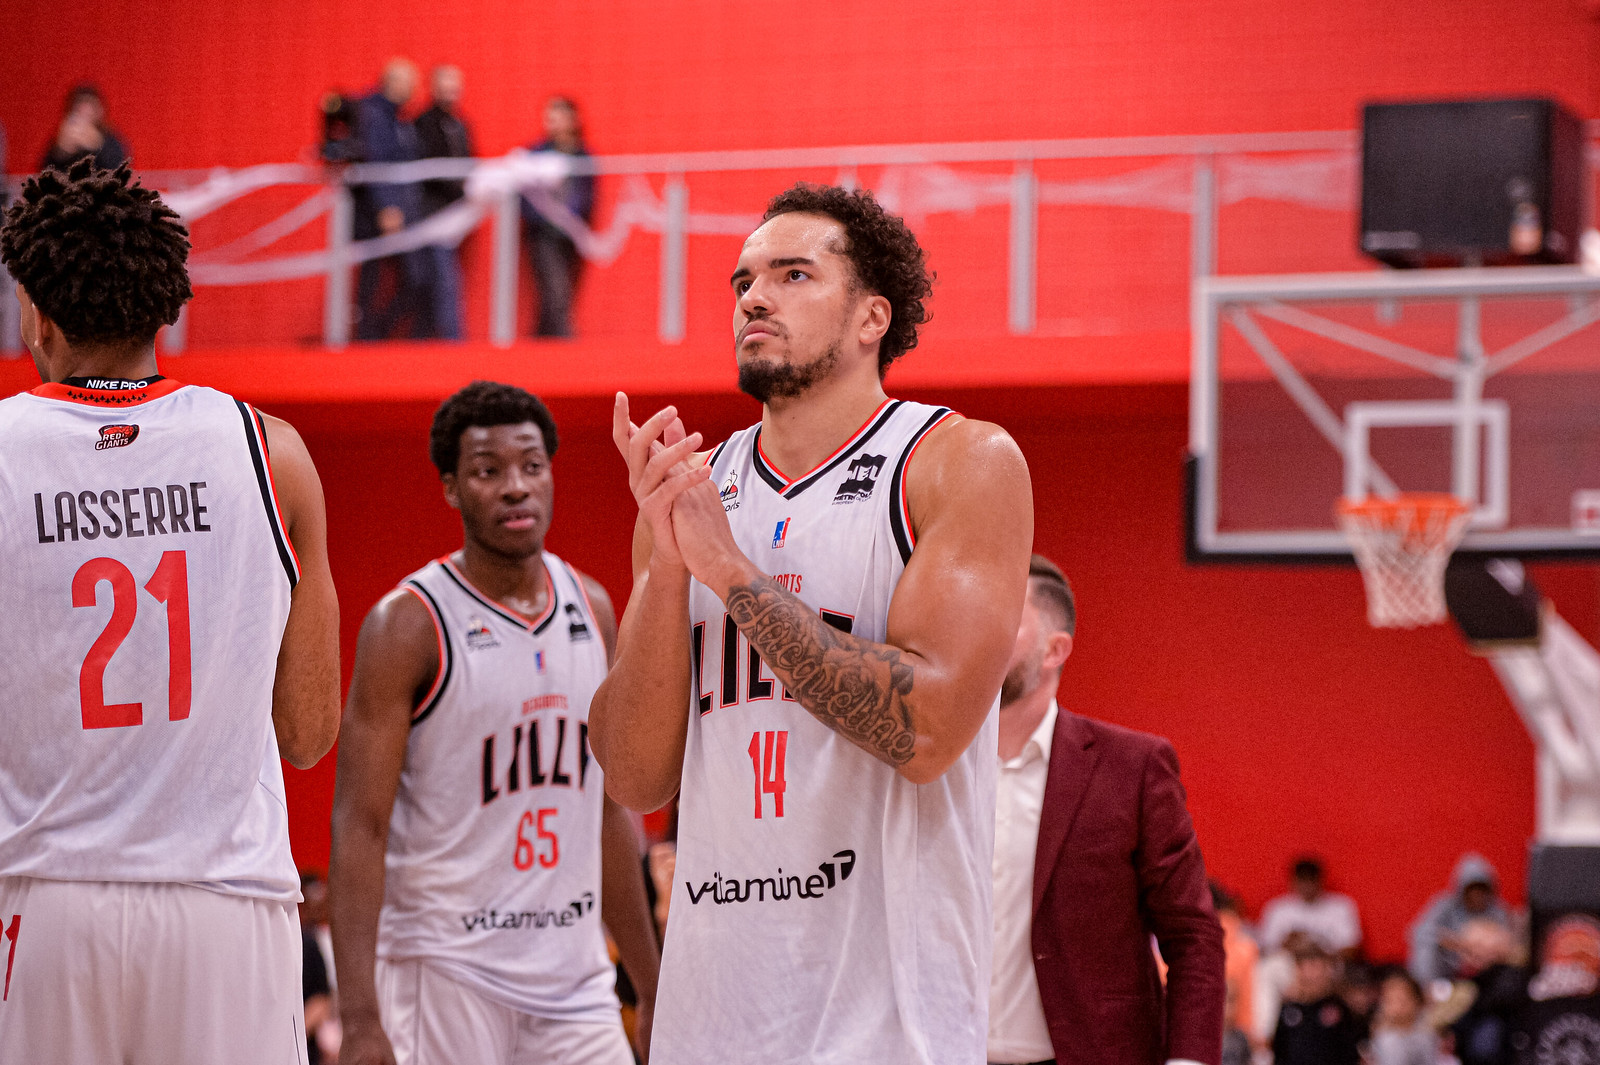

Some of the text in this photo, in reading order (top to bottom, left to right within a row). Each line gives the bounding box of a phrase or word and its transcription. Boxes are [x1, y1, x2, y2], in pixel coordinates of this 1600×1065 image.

[86, 379, 148, 390] NIKE PRO
[96, 438, 129, 450] GIANTS
[103, 433, 121, 441] RED
[34, 481, 211, 543] LASSERRE
[772, 539, 785, 550] LNB
[71, 550, 192, 730] 21
[693, 608, 855, 717] LIL
[747, 731, 788, 819] 14
[513, 807, 560, 872] 65
[0, 914, 22, 1002] 1
